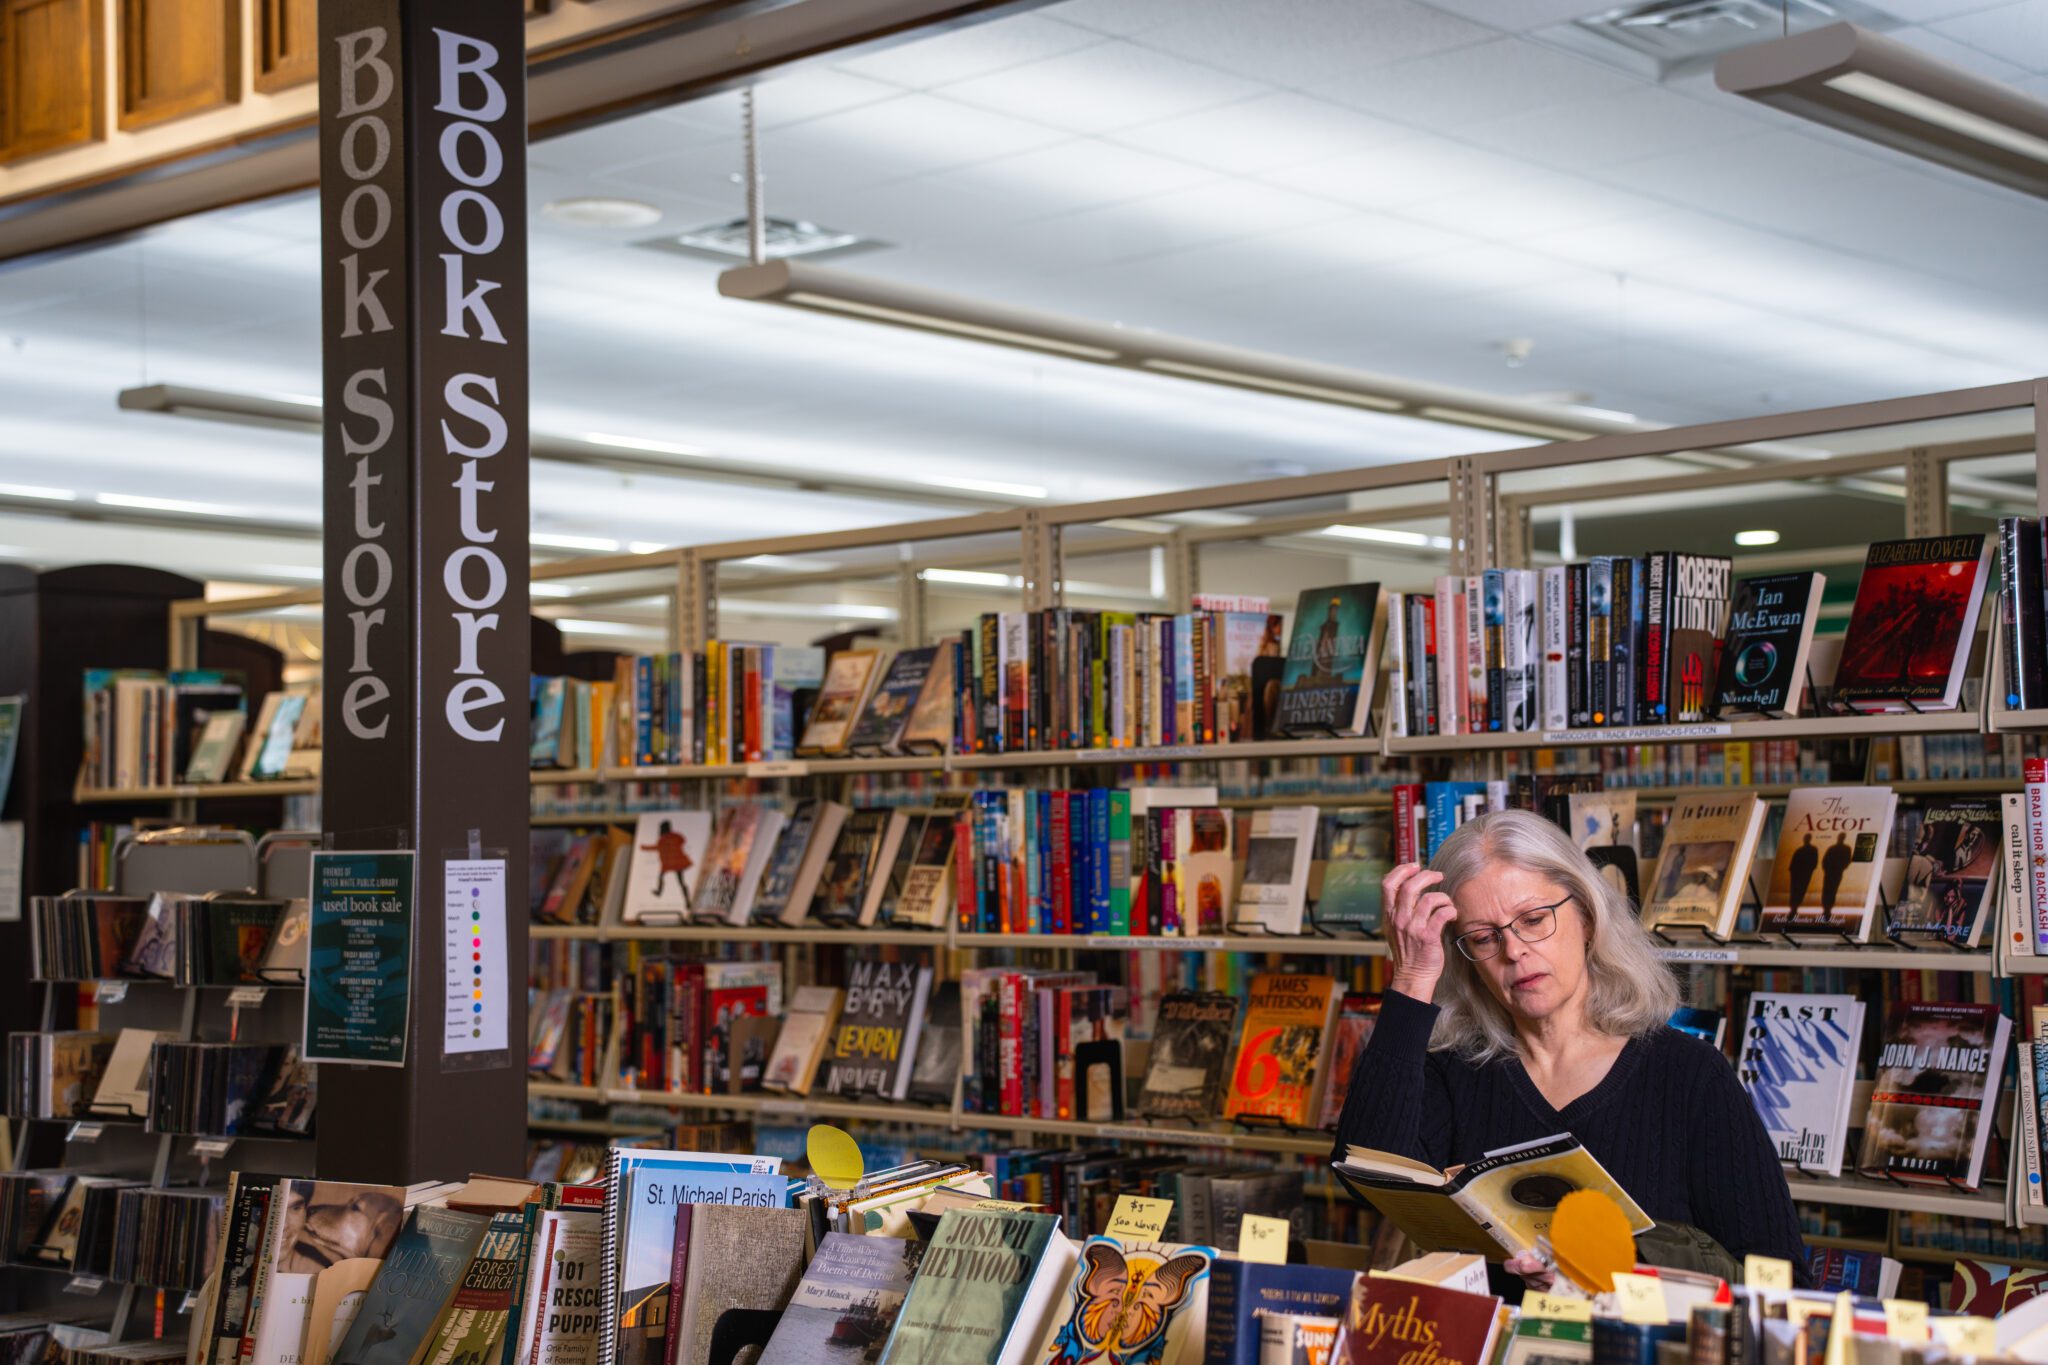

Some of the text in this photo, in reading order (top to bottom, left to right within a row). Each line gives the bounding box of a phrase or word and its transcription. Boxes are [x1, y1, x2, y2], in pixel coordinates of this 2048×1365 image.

[334, 26, 395, 741] Book Store
[432, 27, 509, 743] Book Store
[1869, 538, 1976, 564] ELIZABETH LOWELL
[1676, 555, 1732, 599] ROBERT
[1649, 555, 1664, 625] ROBERT LUDLUM
[1756, 587, 1784, 606] Ian
[1731, 609, 1802, 631] McEwan
[1283, 687, 1350, 711] LINDSEY
[1550, 732, 1598, 741] HARDCOVER
[1601, 730, 1628, 740] TRADE
[1817, 796, 1850, 816] The
[2031, 788, 2041, 818] BRAD
[1794, 812, 1871, 832] Actor
[2032, 820, 2044, 851] THOR
[2010, 823, 2023, 894] call it sleep
[322, 867, 352, 877] FRIENDS OF
[322, 878, 339, 887] PETER
[357, 879, 375, 888] PUBLIC
[376, 878, 399, 888] LIBRARY
[322, 896, 402, 913] used book sale
[2035, 871, 2048, 931] BACKLASH
[1926, 921, 1971, 937] MOORE
[1695, 951, 1728, 961] FICTION
[850, 960, 916, 989] MAX
[1268, 977, 1311, 993] JAMES
[844, 986, 913, 1018] BARRY
[1250, 994, 1324, 1010] PATTERSON
[1750, 1000, 1839, 1022] FAST
[1236, 1026, 1283, 1098] 6
[1879, 1043, 1989, 1073] JOHN J. NANCE
[2023, 1085, 2033, 1127] CROSSING
[1799, 1127, 1828, 1149] JUDY
[1471, 1146, 1552, 1174] LARRY McMURTRY
[1779, 1141, 1825, 1165] MERCER
[1888, 1155, 1895, 1166] A
[2027, 1139, 2036, 1172] SAFETY
[647, 1183, 777, 1208] St. Michael Parish
[234, 1194, 251, 1265] INTO THIN AIR
[266, 1208, 277, 1235] TRUTH
[419, 1219, 473, 1239] BARRY LOPEZ
[945, 1215, 1036, 1250] JOSEPH
[261, 1237, 272, 1262] ABOUT
[824, 1251, 838, 1261] You
[839, 1254, 860, 1265] Know
[867, 1257, 889, 1267] House
[827, 1241, 880, 1256] A Time When
[389, 1246, 461, 1284] WINTER
[470, 1260, 518, 1276] FOREST
[557, 1261, 585, 1281] 101
[816, 1263, 895, 1281] Poems of Detroit
[920, 1246, 1032, 1285] HEYWOOD
[376, 1270, 447, 1301] COUNT
[465, 1274, 514, 1290] CHURCH
[1464, 1269, 1486, 1289] John
[552, 1287, 602, 1307] RESCU
[730, 1298, 744, 1309] The
[805, 1285, 852, 1301] Mary Minock
[671, 1290, 680, 1329] Journey
[536, 1303, 546, 1339] RESCUE
[548, 1313, 600, 1334] PUPPI
[911, 1320, 924, 1328] novel
[924, 1322, 930, 1330] by
[940, 1324, 957, 1333] author
[963, 1326, 974, 1335] THE
[1352, 1295, 1439, 1351] Myths
[546, 1344, 562, 1353] One
[544, 1355, 587, 1365] of Fostering
